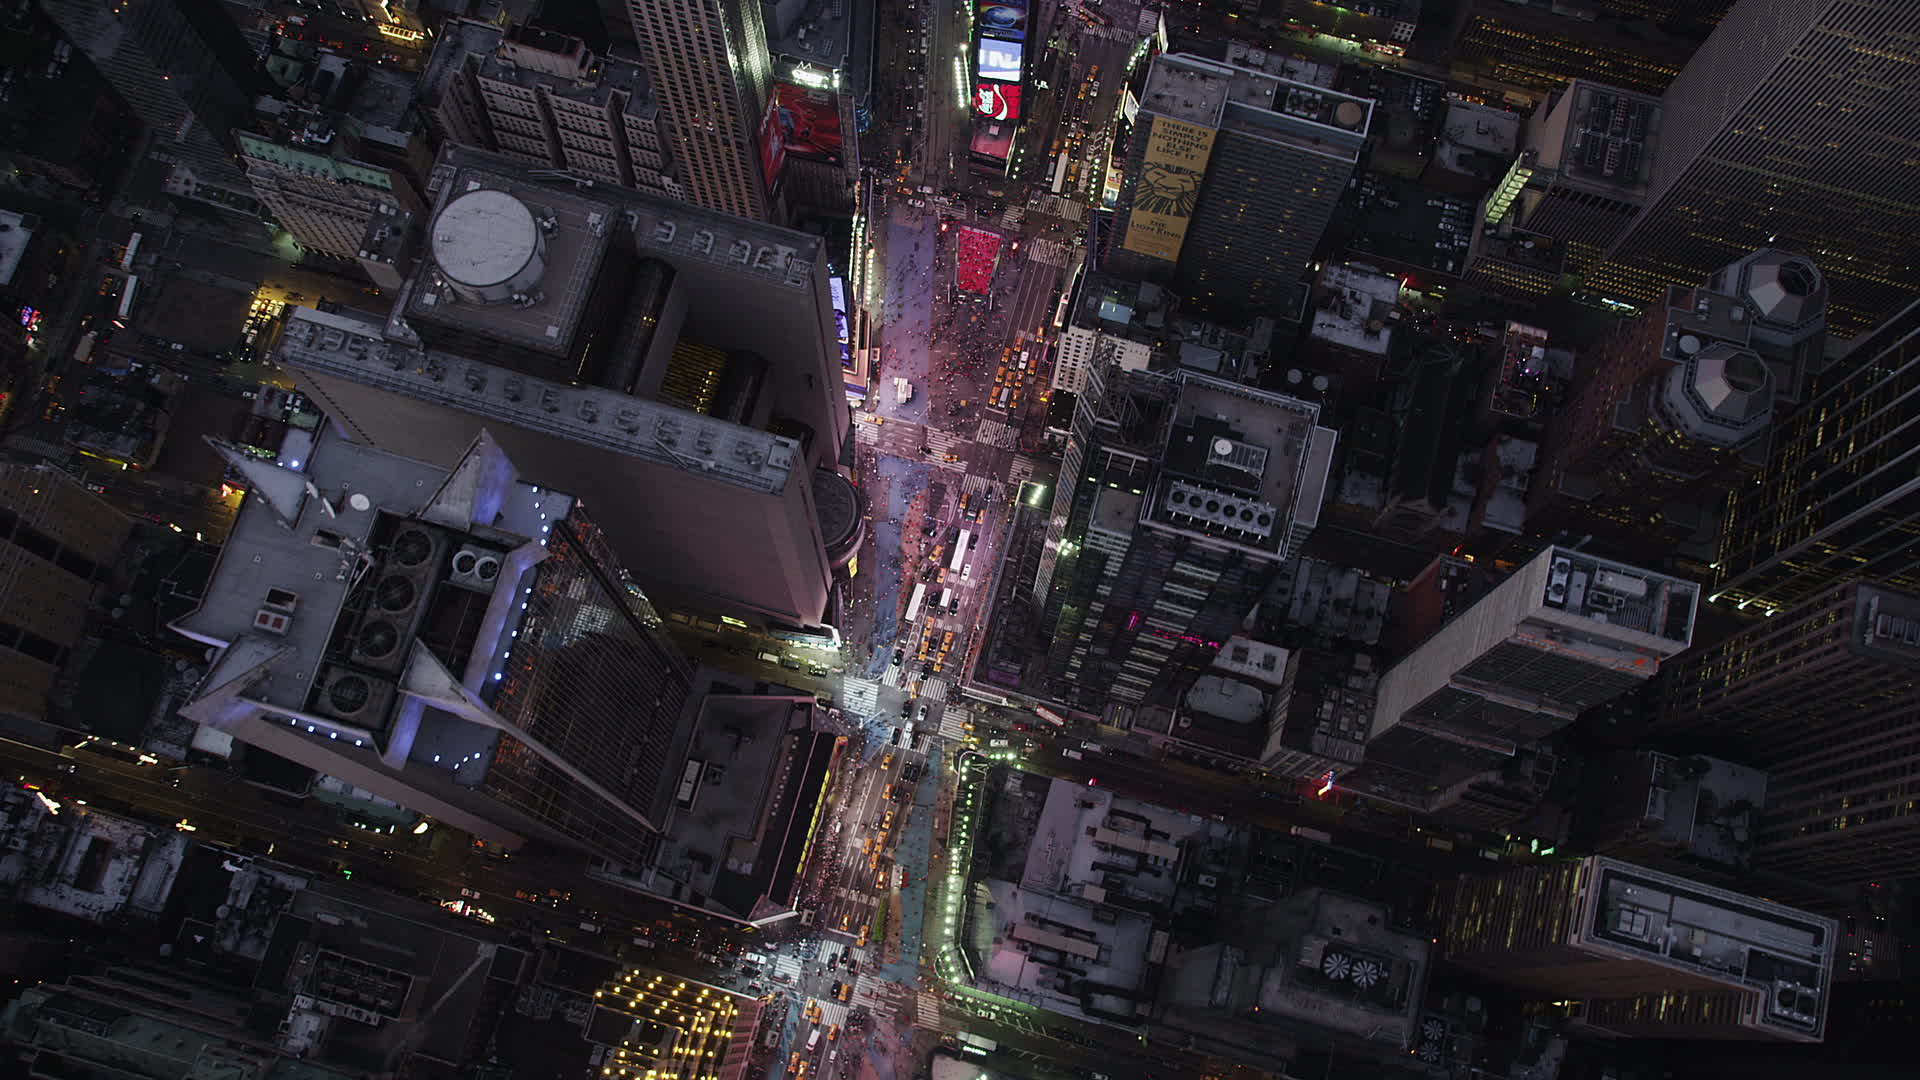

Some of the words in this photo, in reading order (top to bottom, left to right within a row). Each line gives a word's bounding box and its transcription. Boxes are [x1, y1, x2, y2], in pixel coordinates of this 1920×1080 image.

[1161, 121, 1196, 133] THERE
[1197, 129, 1209, 138] IS
[1162, 127, 1203, 142] SIMPLY
[1152, 132, 1209, 151] NOTHING
[1166, 141, 1193, 152] ELSE
[1156, 145, 1182, 157] LIKE
